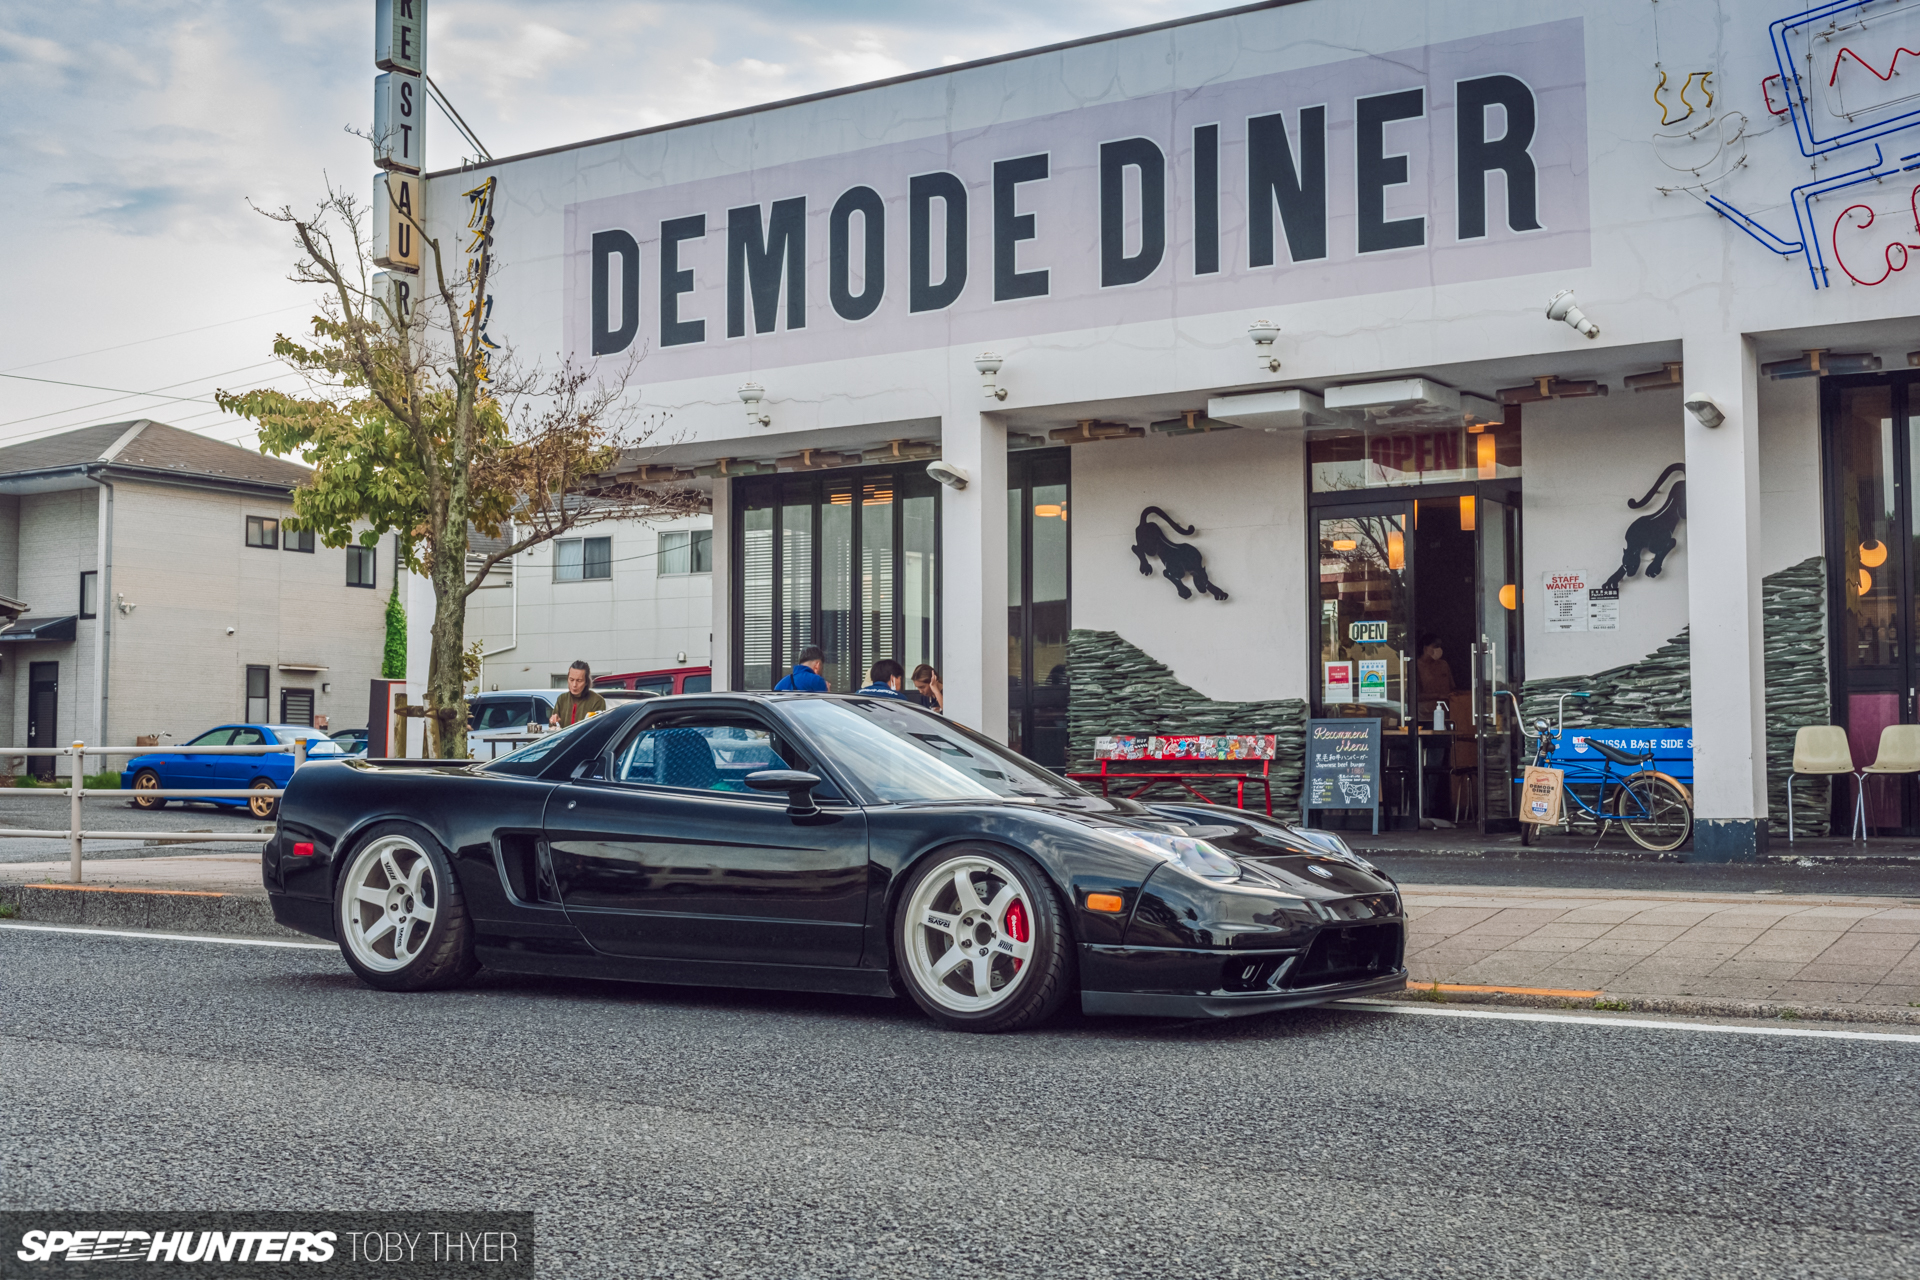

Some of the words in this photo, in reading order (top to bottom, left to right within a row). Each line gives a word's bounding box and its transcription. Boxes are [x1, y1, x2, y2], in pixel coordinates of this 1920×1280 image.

[590, 151, 1053, 358] DEMODE
[1098, 73, 1548, 290] DINER
[1369, 432, 1459, 476] OPEN
[1546, 582, 1584, 590] WANTED
[1552, 576, 1579, 584] STAFF
[1352, 623, 1384, 640] OPEN
[1335, 740, 1369, 752] Menu
[1630, 739, 1657, 749] BASE
[1660, 739, 1684, 749] SIDE
